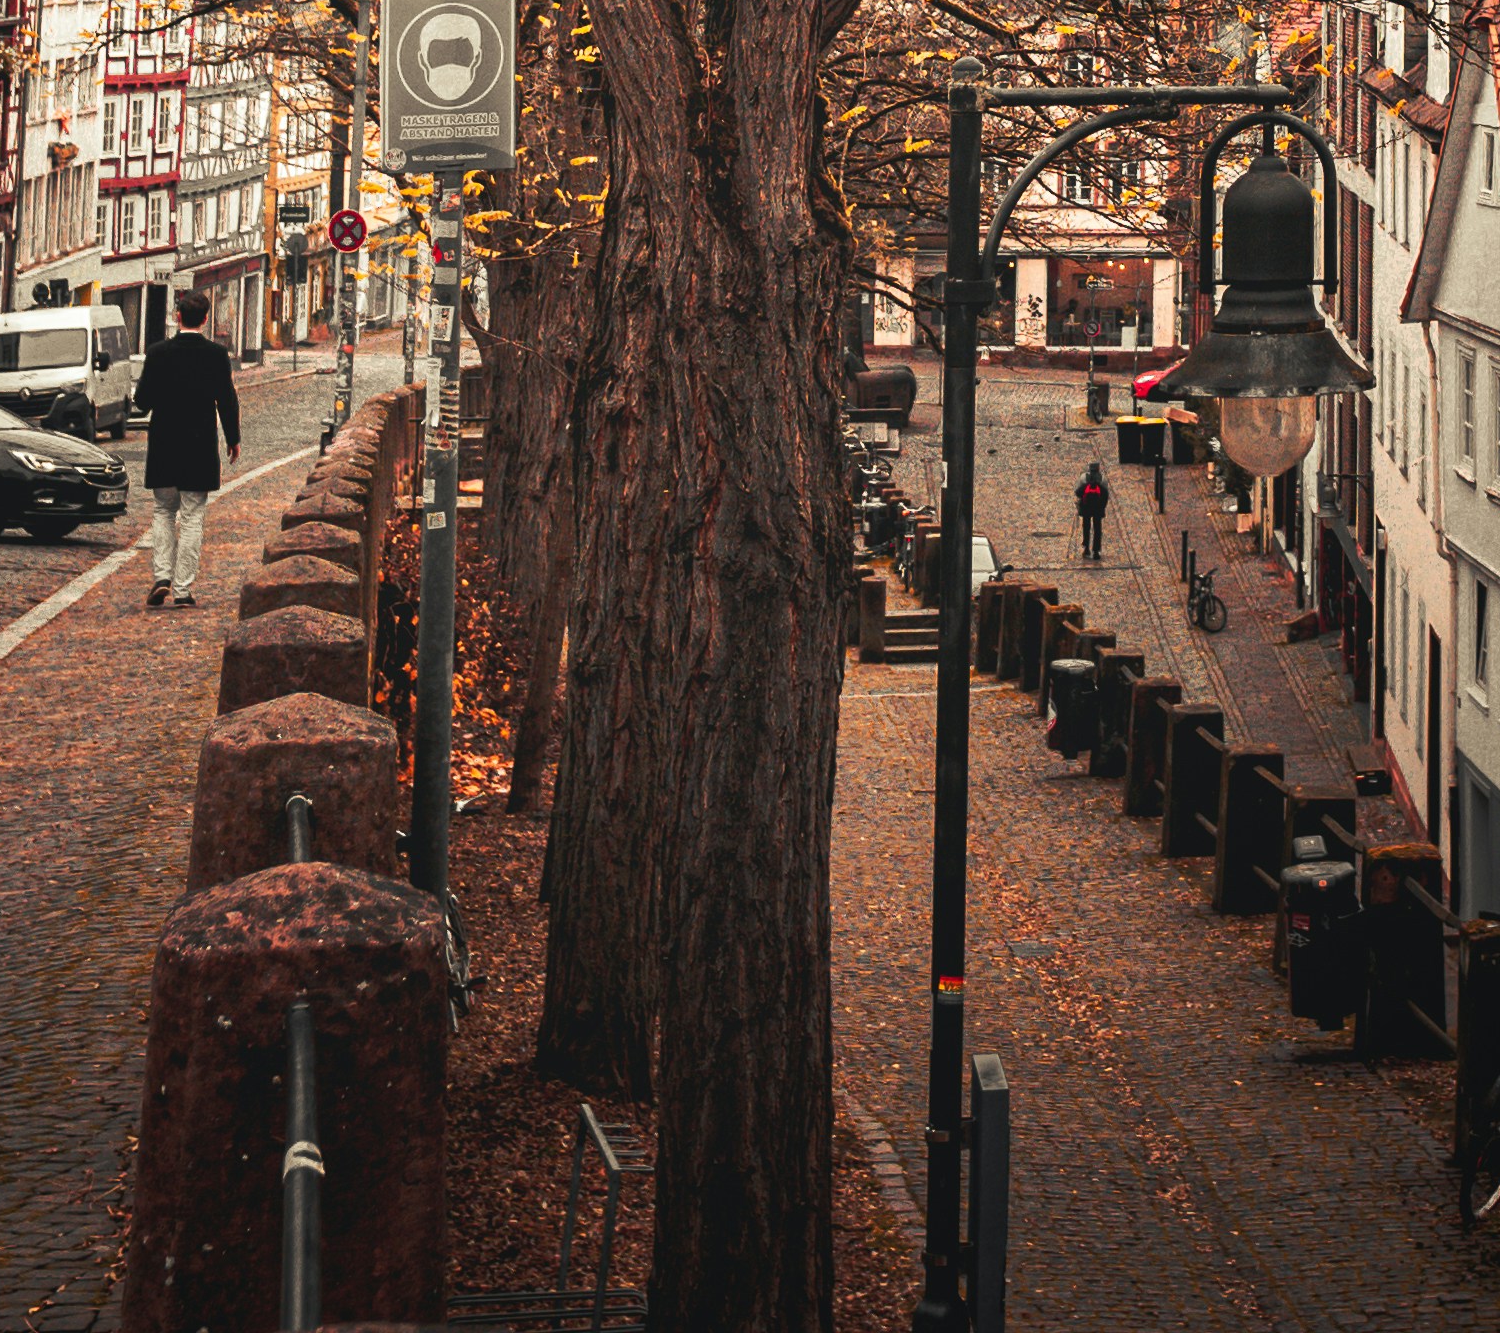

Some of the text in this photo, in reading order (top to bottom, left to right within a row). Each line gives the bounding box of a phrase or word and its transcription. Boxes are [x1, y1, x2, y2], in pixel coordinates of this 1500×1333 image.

[401, 112, 499, 127] MASKE TRAGEN &
[400, 125, 499, 140] ABSTAND HALTEN
